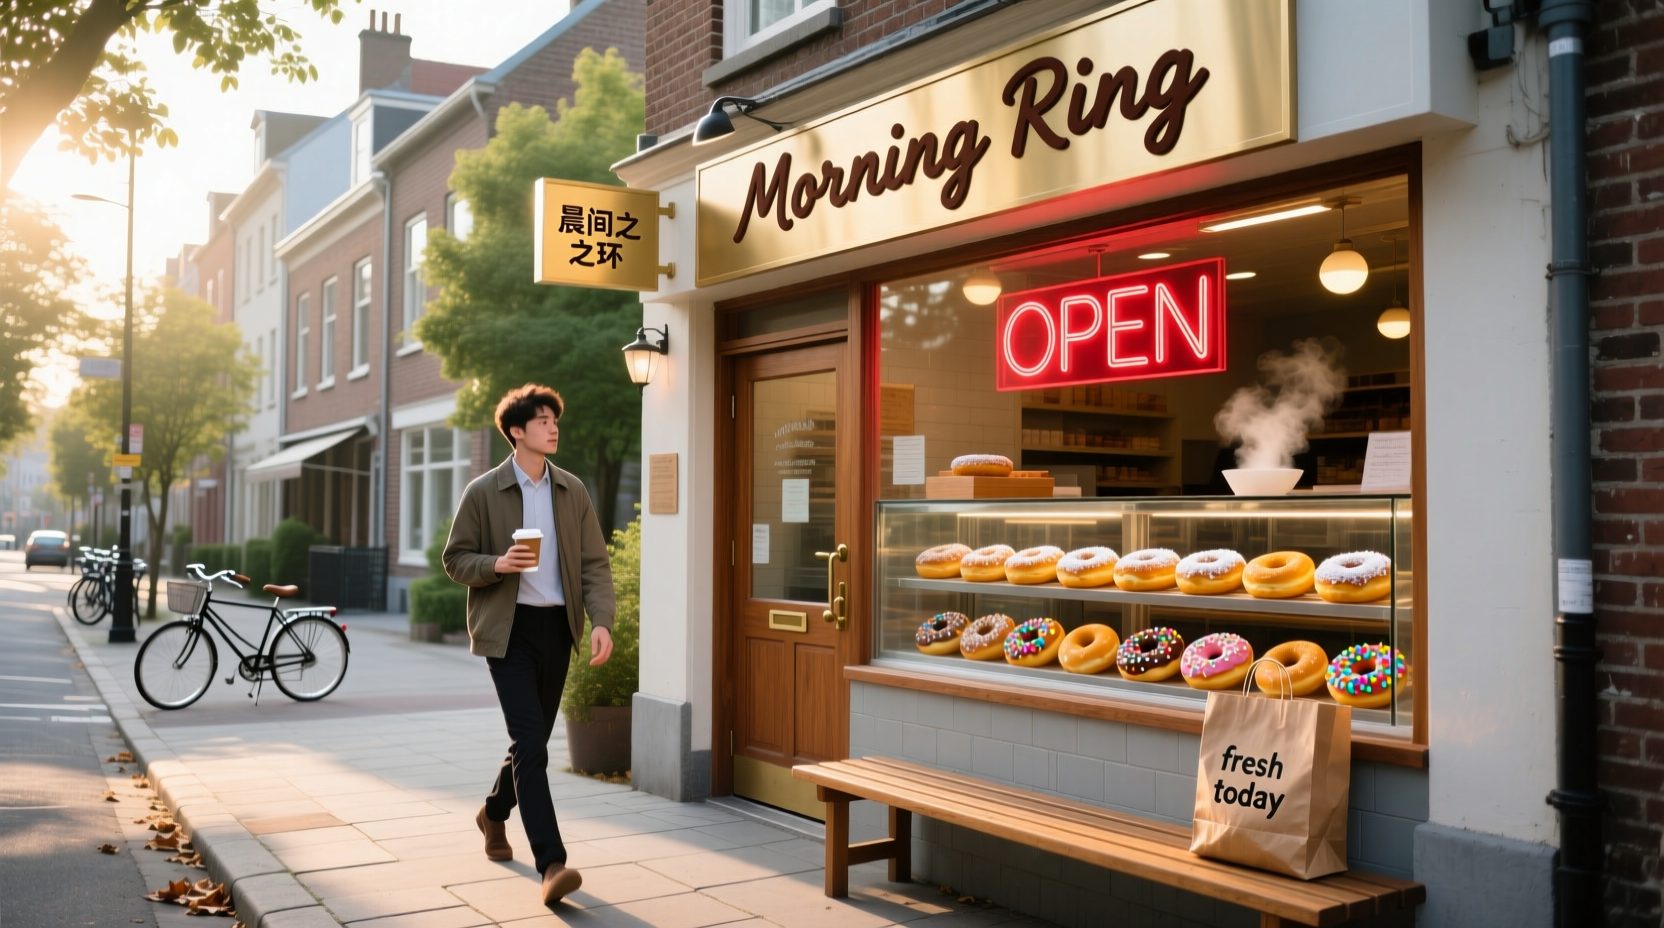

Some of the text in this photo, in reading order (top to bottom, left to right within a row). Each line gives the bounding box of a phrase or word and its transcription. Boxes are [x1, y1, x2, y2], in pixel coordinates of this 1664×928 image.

[732, 48, 1210, 244] Morning Ring
[558, 204, 641, 240] 晨间之
[569, 239, 623, 269] 之环
[1003, 275, 1208, 377] OPEN
[1221, 745, 1283, 779] fresh
[1214, 779, 1285, 819] today
